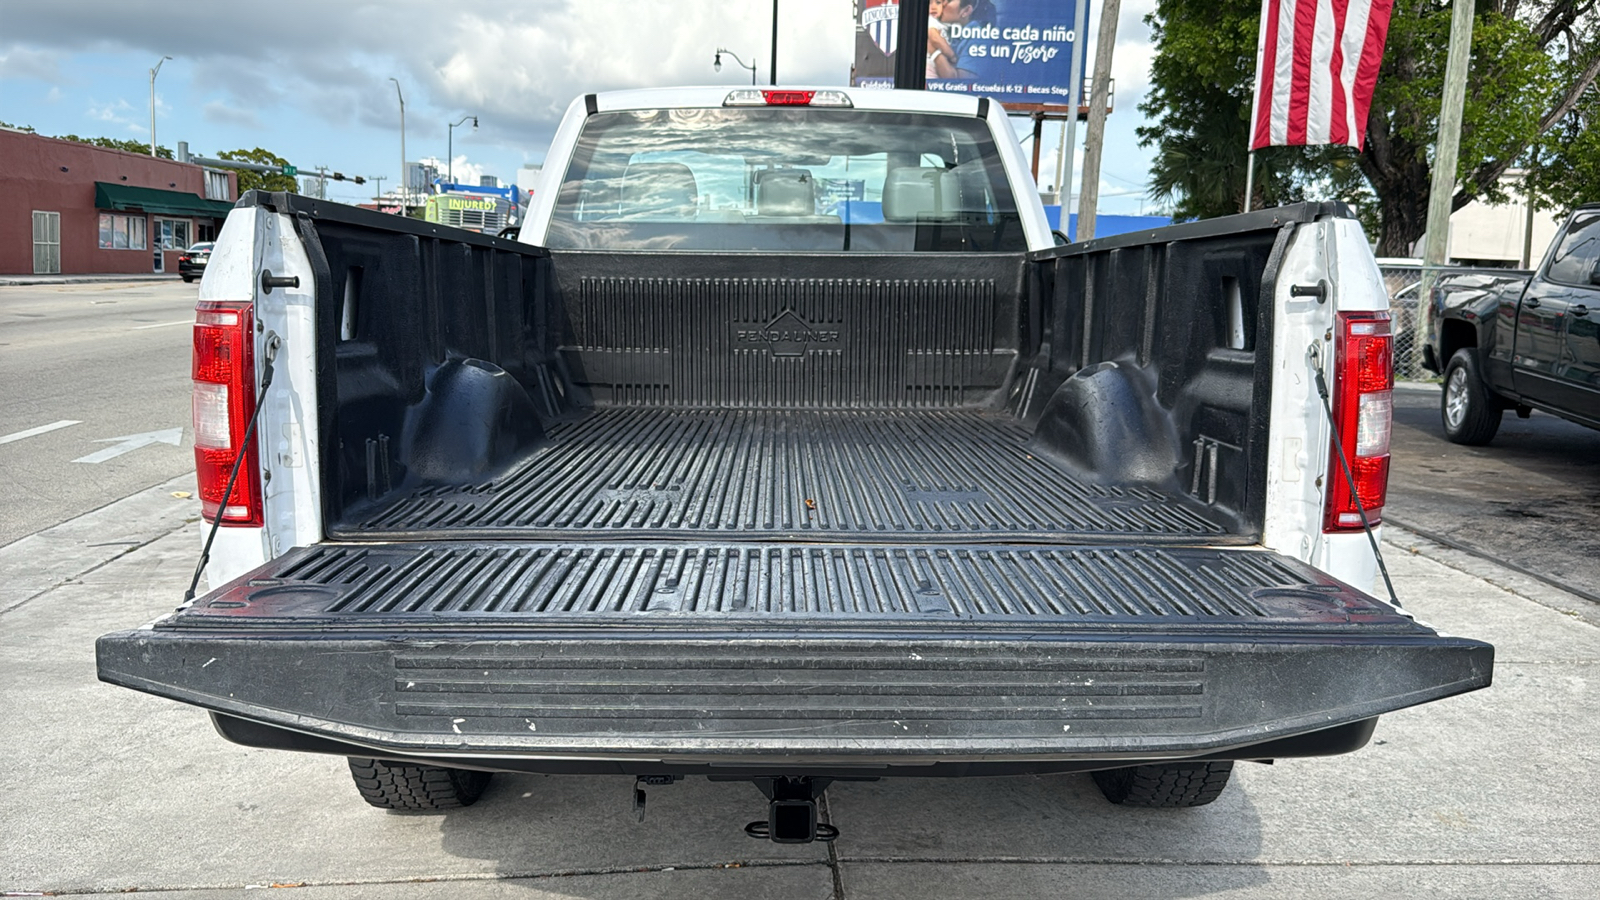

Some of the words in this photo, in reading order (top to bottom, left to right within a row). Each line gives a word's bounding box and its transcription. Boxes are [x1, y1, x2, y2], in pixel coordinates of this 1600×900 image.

[951, 23, 999, 39] Donde
[1002, 24, 1039, 40] cada
[1043, 24, 1075, 42] niño
[968, 45, 986, 56] es
[990, 46, 1009, 57] un
[1011, 41, 1058, 63] Tesoro
[928, 83, 944, 91] VPK
[945, 83, 967, 92] Gratis
[972, 84, 1004, 93] Escuelas
[1006, 85, 1023, 93] K-12
[1027, 85, 1049, 94] Becas
[1051, 86, 1069, 96] Step
[449, 198, 497, 210] INJURED?
[736, 330, 840, 342] PENDALINER
